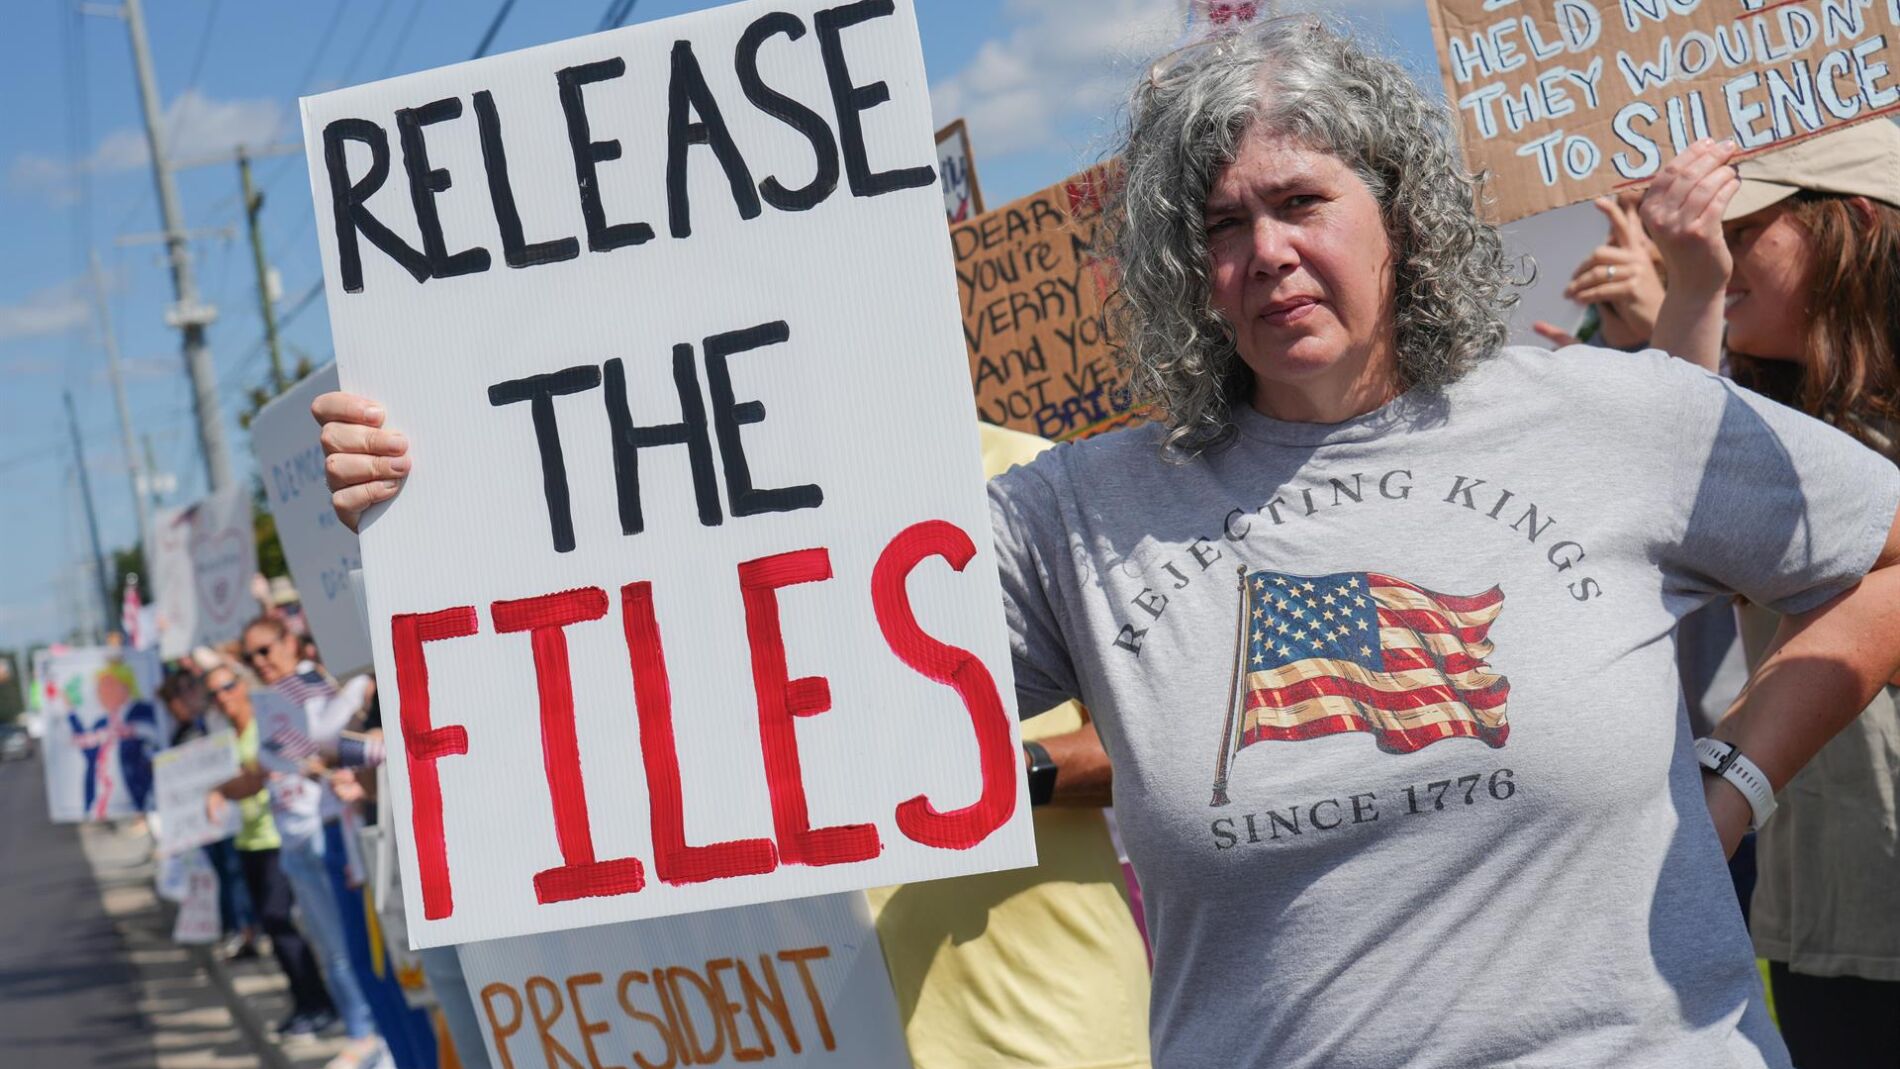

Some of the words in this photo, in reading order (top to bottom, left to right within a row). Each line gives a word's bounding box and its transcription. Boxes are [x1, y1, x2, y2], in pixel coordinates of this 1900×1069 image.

[1449, 1, 1600, 84] HELD
[1459, 56, 1603, 140] THEY
[1616, 0, 1900, 95] WOULDN
[323, 0, 937, 294] RELEASE
[1516, 128, 1601, 186] TO
[950, 199, 1063, 262] DEAR
[962, 263, 1081, 354] VERRY
[1054, 316, 1109, 375] YO
[488, 320, 824, 553] THE
[1034, 384, 1133, 441] BRIG
[1112, 469, 1415, 658] REJECTING
[1443, 474, 1603, 602] KINGS
[391, 520, 1017, 920] FILES
[1210, 791, 1380, 851] SINCE
[1401, 768, 1517, 817] 1776
[480, 945, 836, 1069] PRESIDENT
